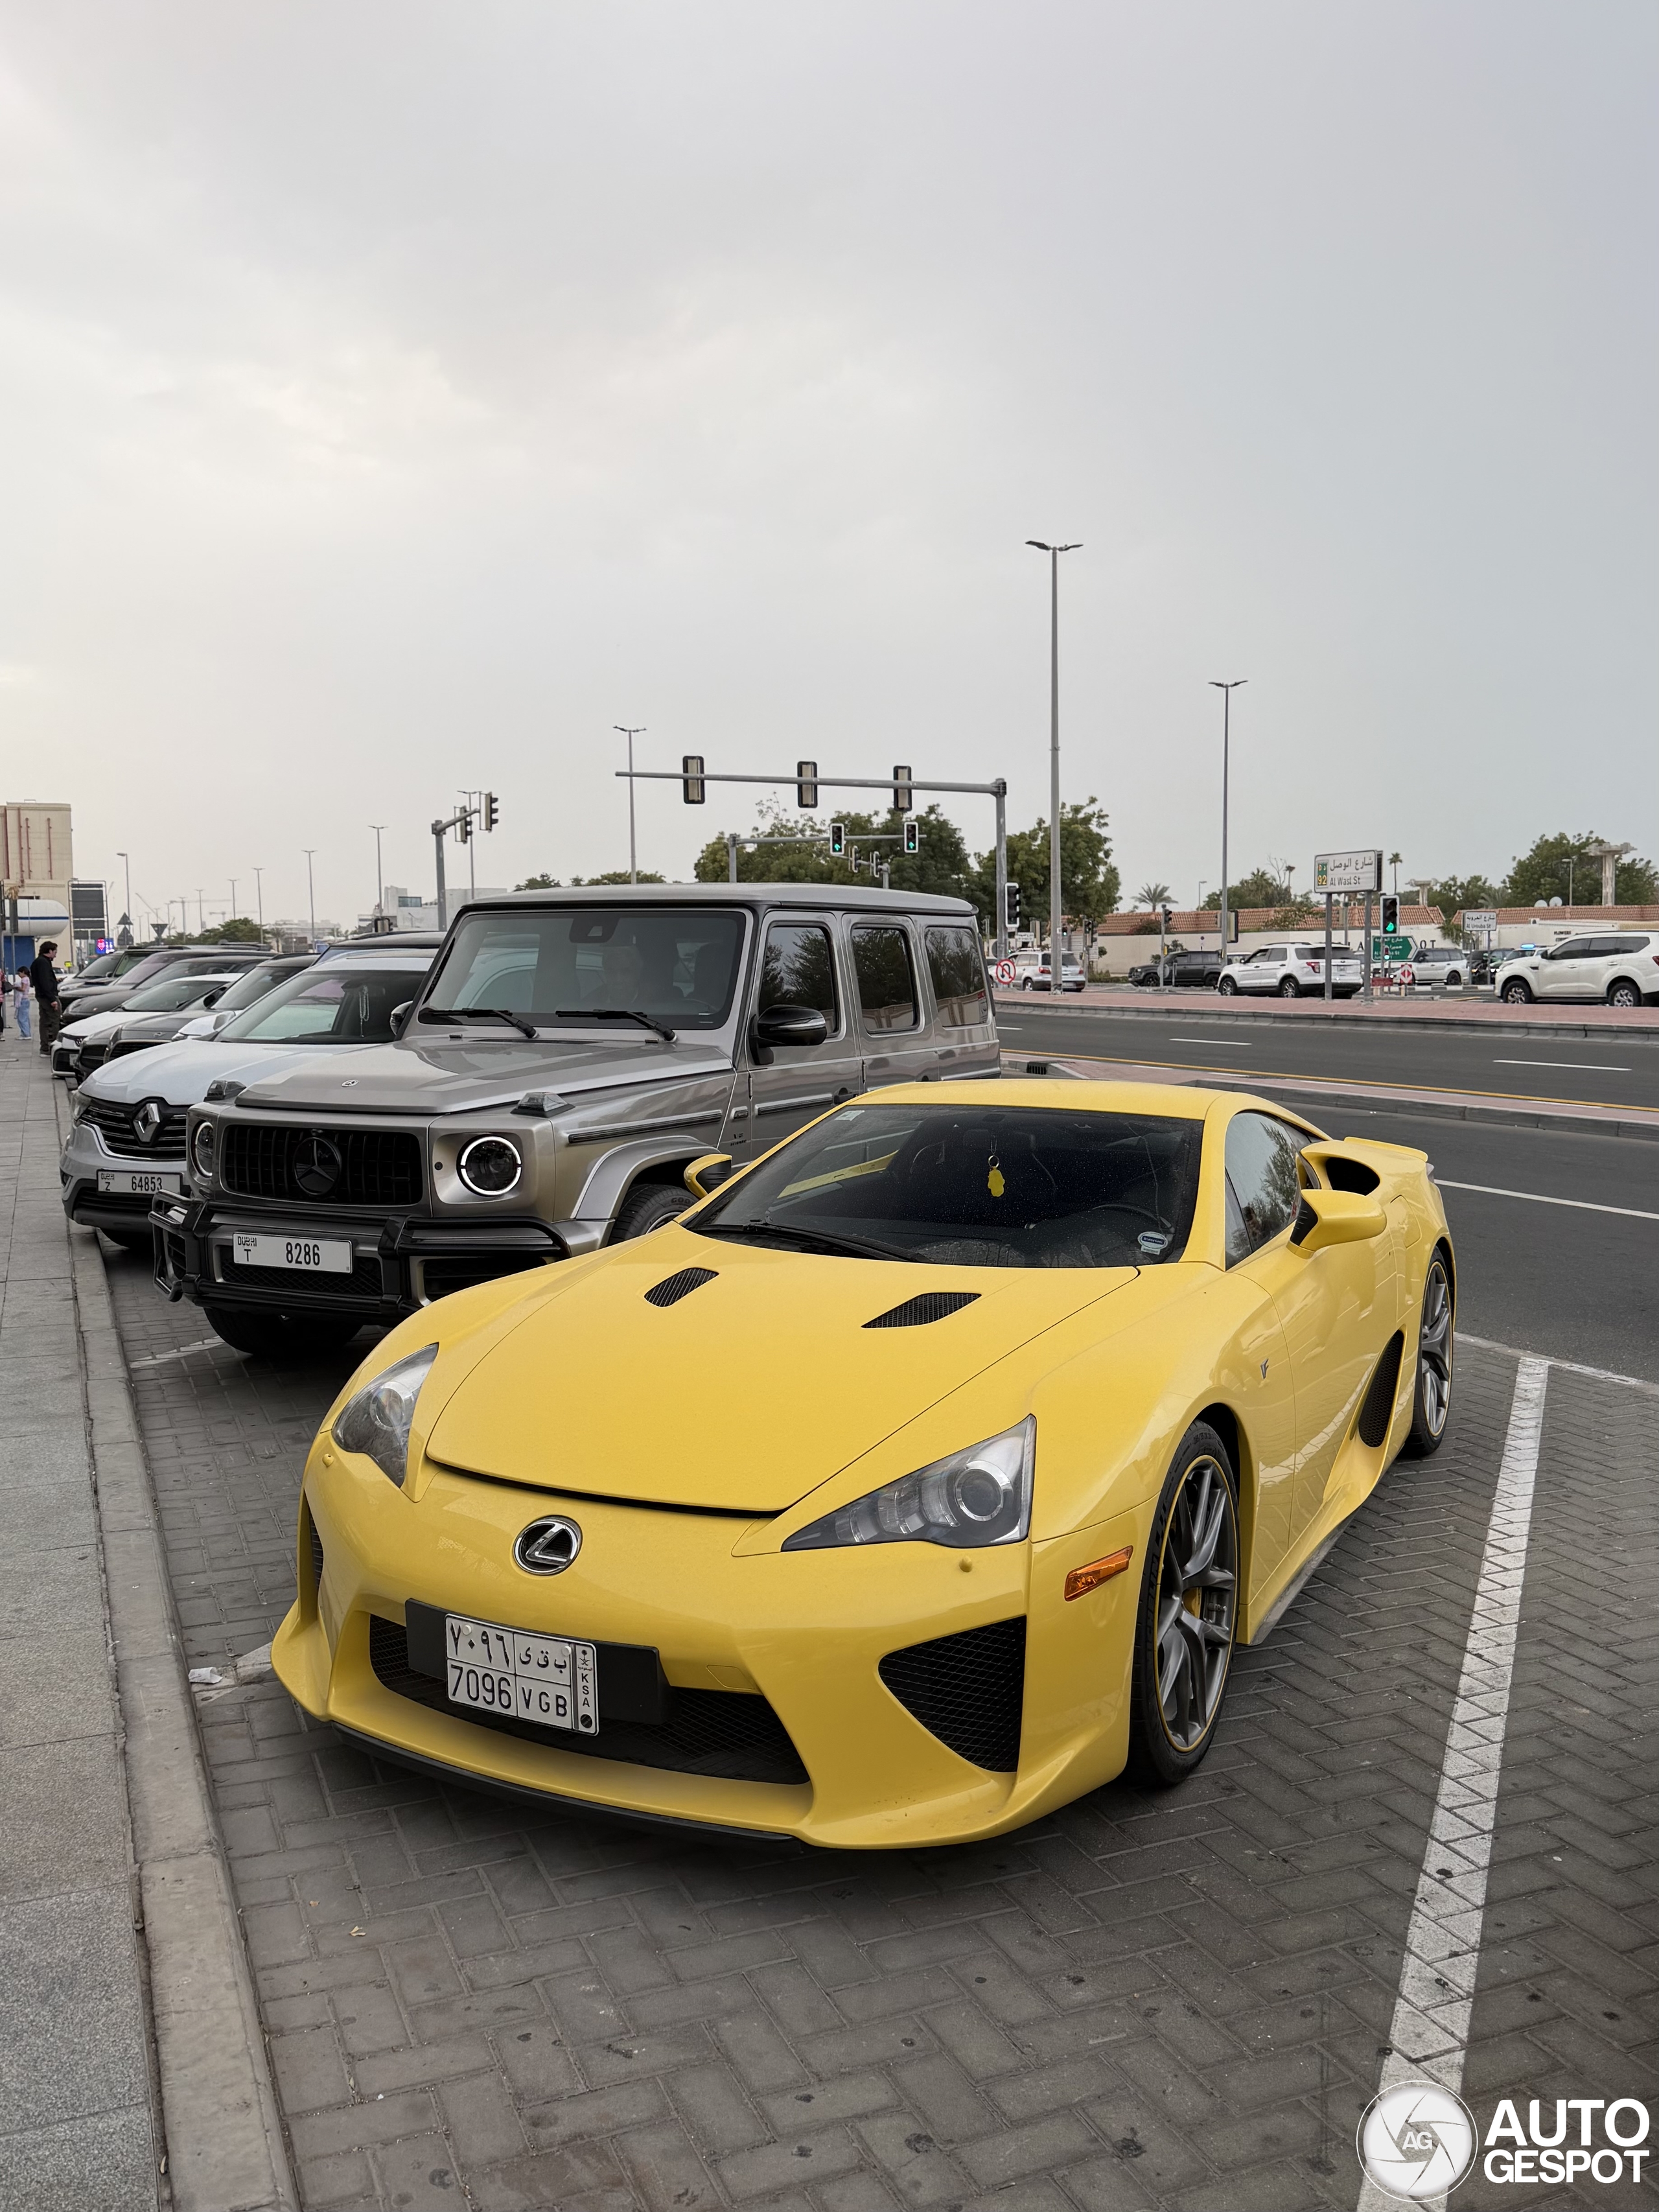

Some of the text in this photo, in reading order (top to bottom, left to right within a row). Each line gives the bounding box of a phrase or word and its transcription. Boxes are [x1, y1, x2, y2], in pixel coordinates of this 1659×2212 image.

[1330, 856, 1373, 871] شارع الوصل
[1317, 875, 1327, 885] 92
[1338, 876, 1352, 886] Wasl
[1353, 876, 1360, 885] St
[105, 1176, 163, 1192] Z 64853
[244, 1242, 320, 1266] T 8286
[450, 1664, 568, 1717] 7096 VGB
